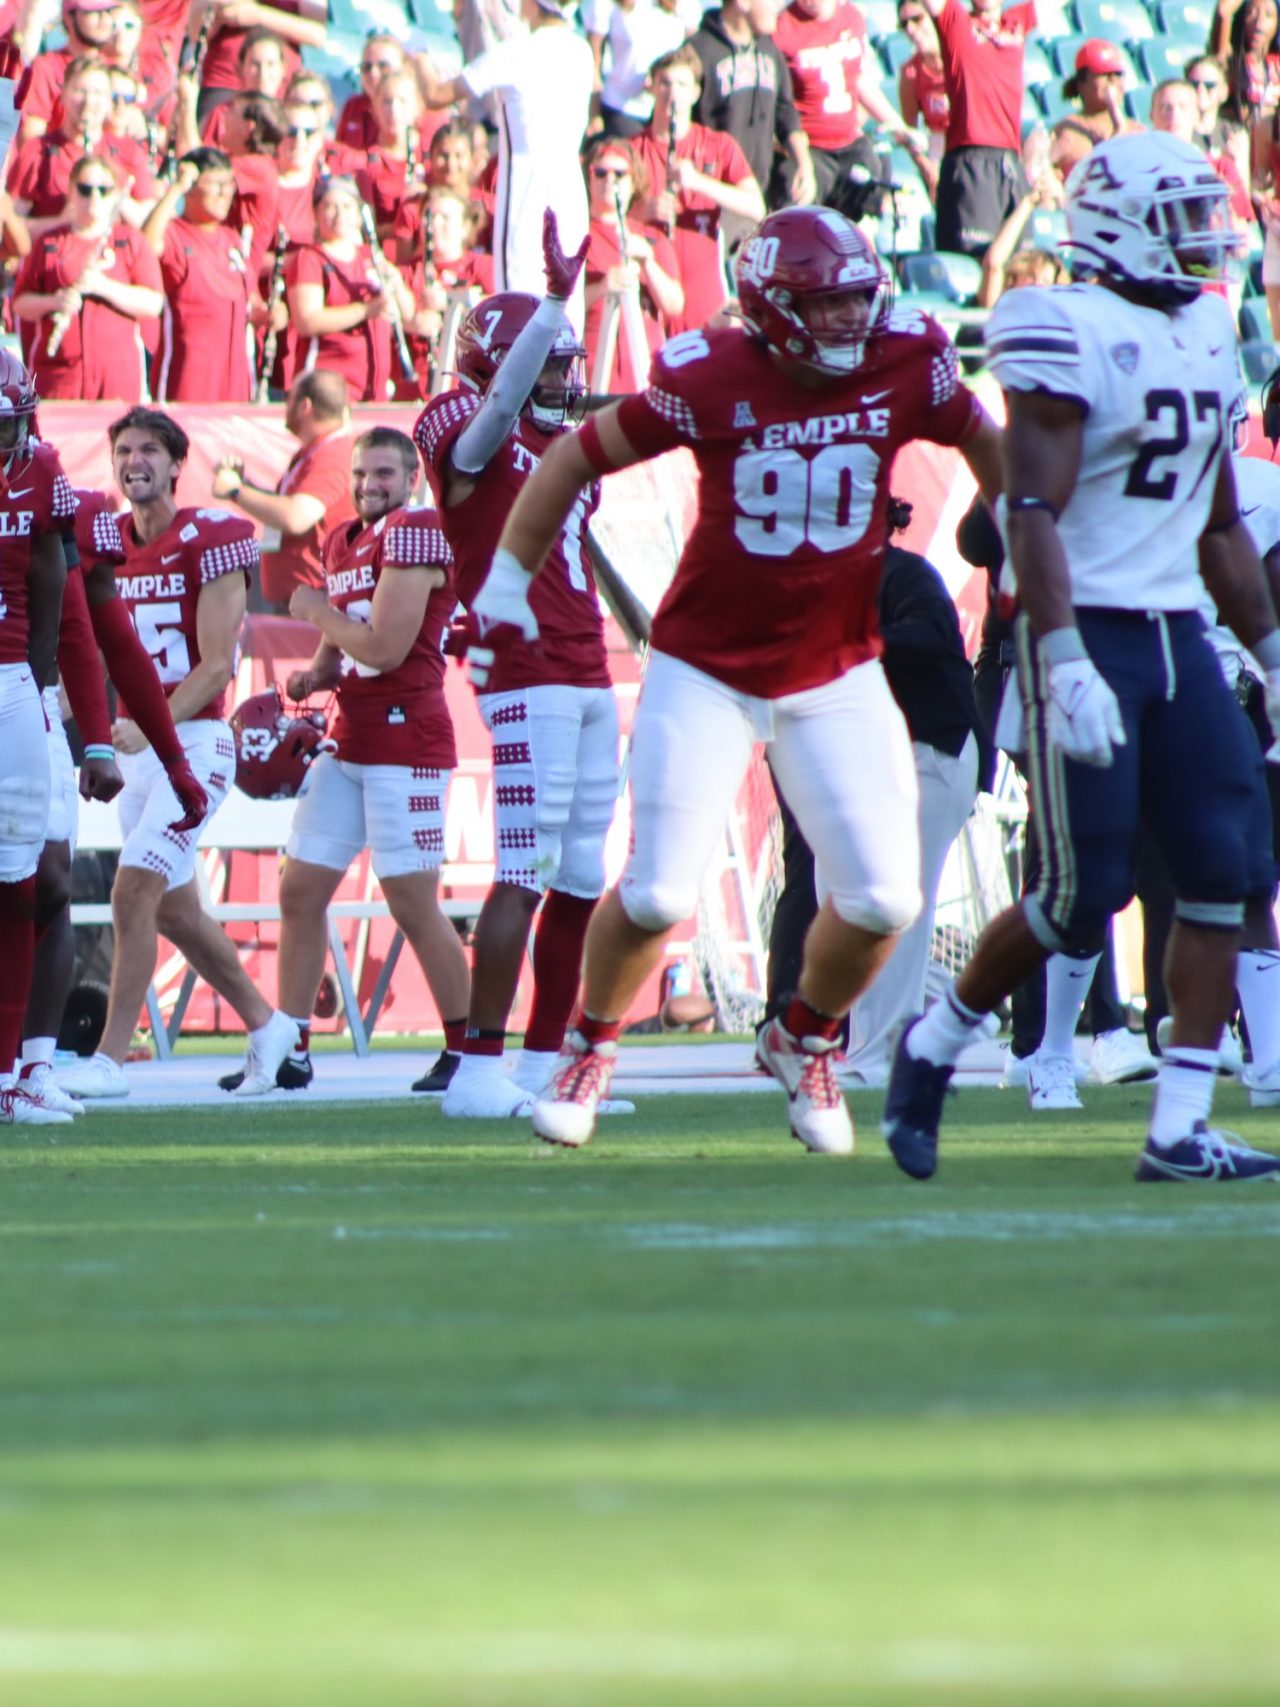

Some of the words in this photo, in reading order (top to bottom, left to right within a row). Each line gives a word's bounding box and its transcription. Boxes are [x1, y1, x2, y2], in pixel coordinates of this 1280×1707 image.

[481, 310, 503, 349] 7
[1123, 388, 1222, 502] 27
[734, 443, 880, 556] 90
[326, 565, 375, 596] EMPLE
[241, 728, 271, 762] 33
